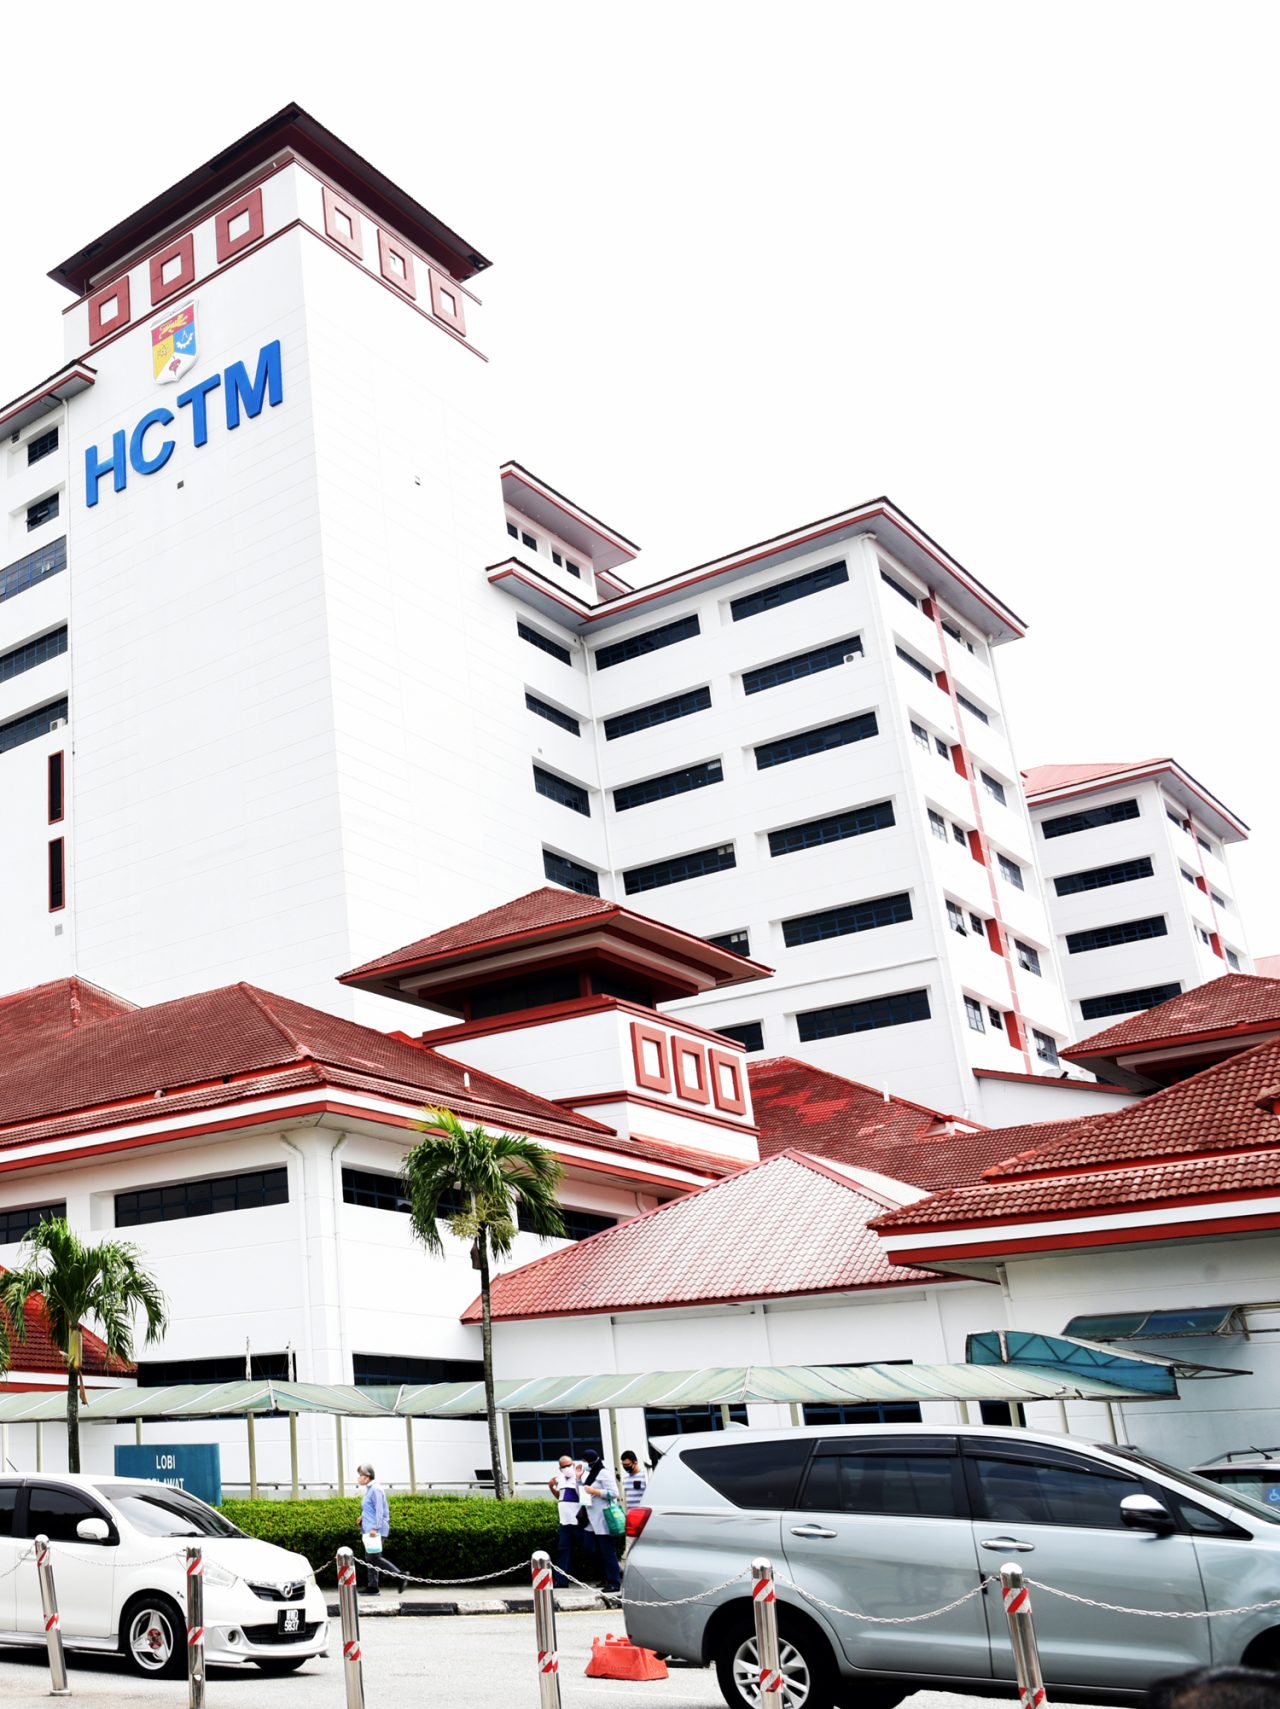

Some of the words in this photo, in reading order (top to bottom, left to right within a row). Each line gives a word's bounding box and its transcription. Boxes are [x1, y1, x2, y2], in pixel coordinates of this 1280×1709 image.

[85, 339, 283, 508] HCTM
[155, 1455, 176, 1469] LOBI
[284, 1620, 299, 1631] 5837
